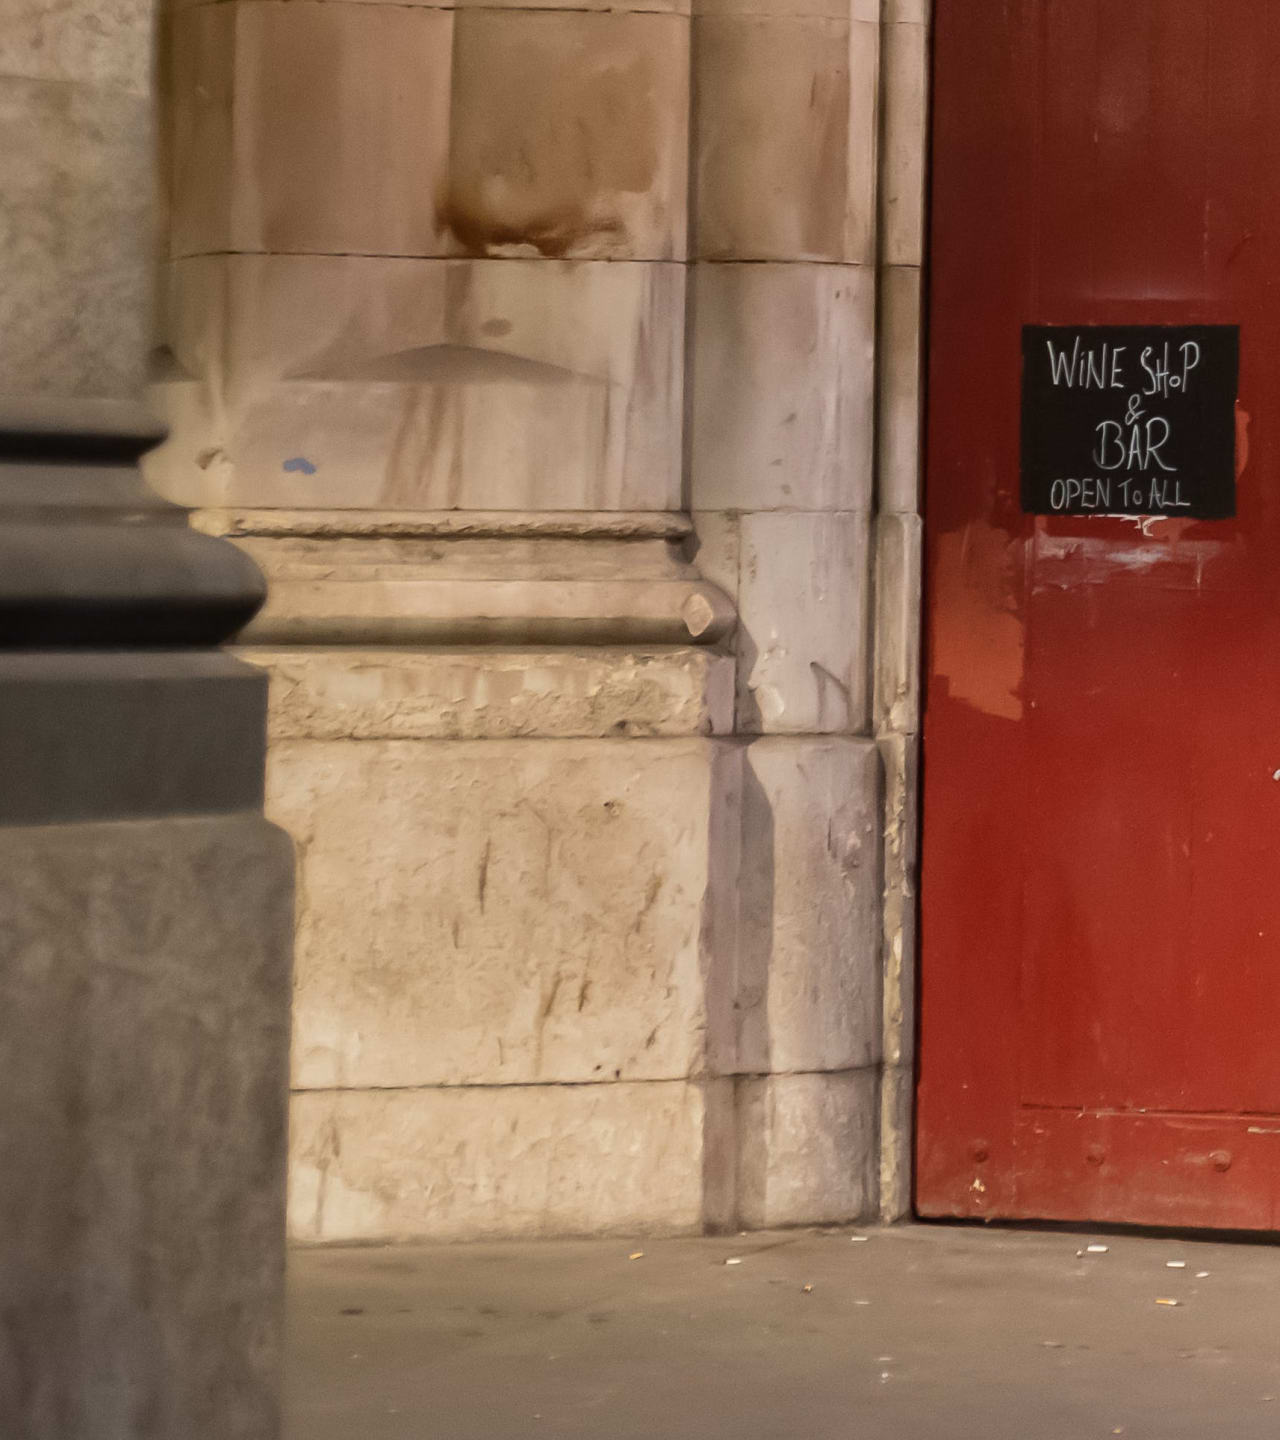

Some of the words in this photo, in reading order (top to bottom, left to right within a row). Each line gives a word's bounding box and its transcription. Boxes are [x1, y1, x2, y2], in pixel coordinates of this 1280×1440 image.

[1125, 394, 1147, 426] &
[1093, 417, 1177, 471] BAR
[1050, 477, 1111, 510] OPEN
[1149, 477, 1191, 509] ALL
